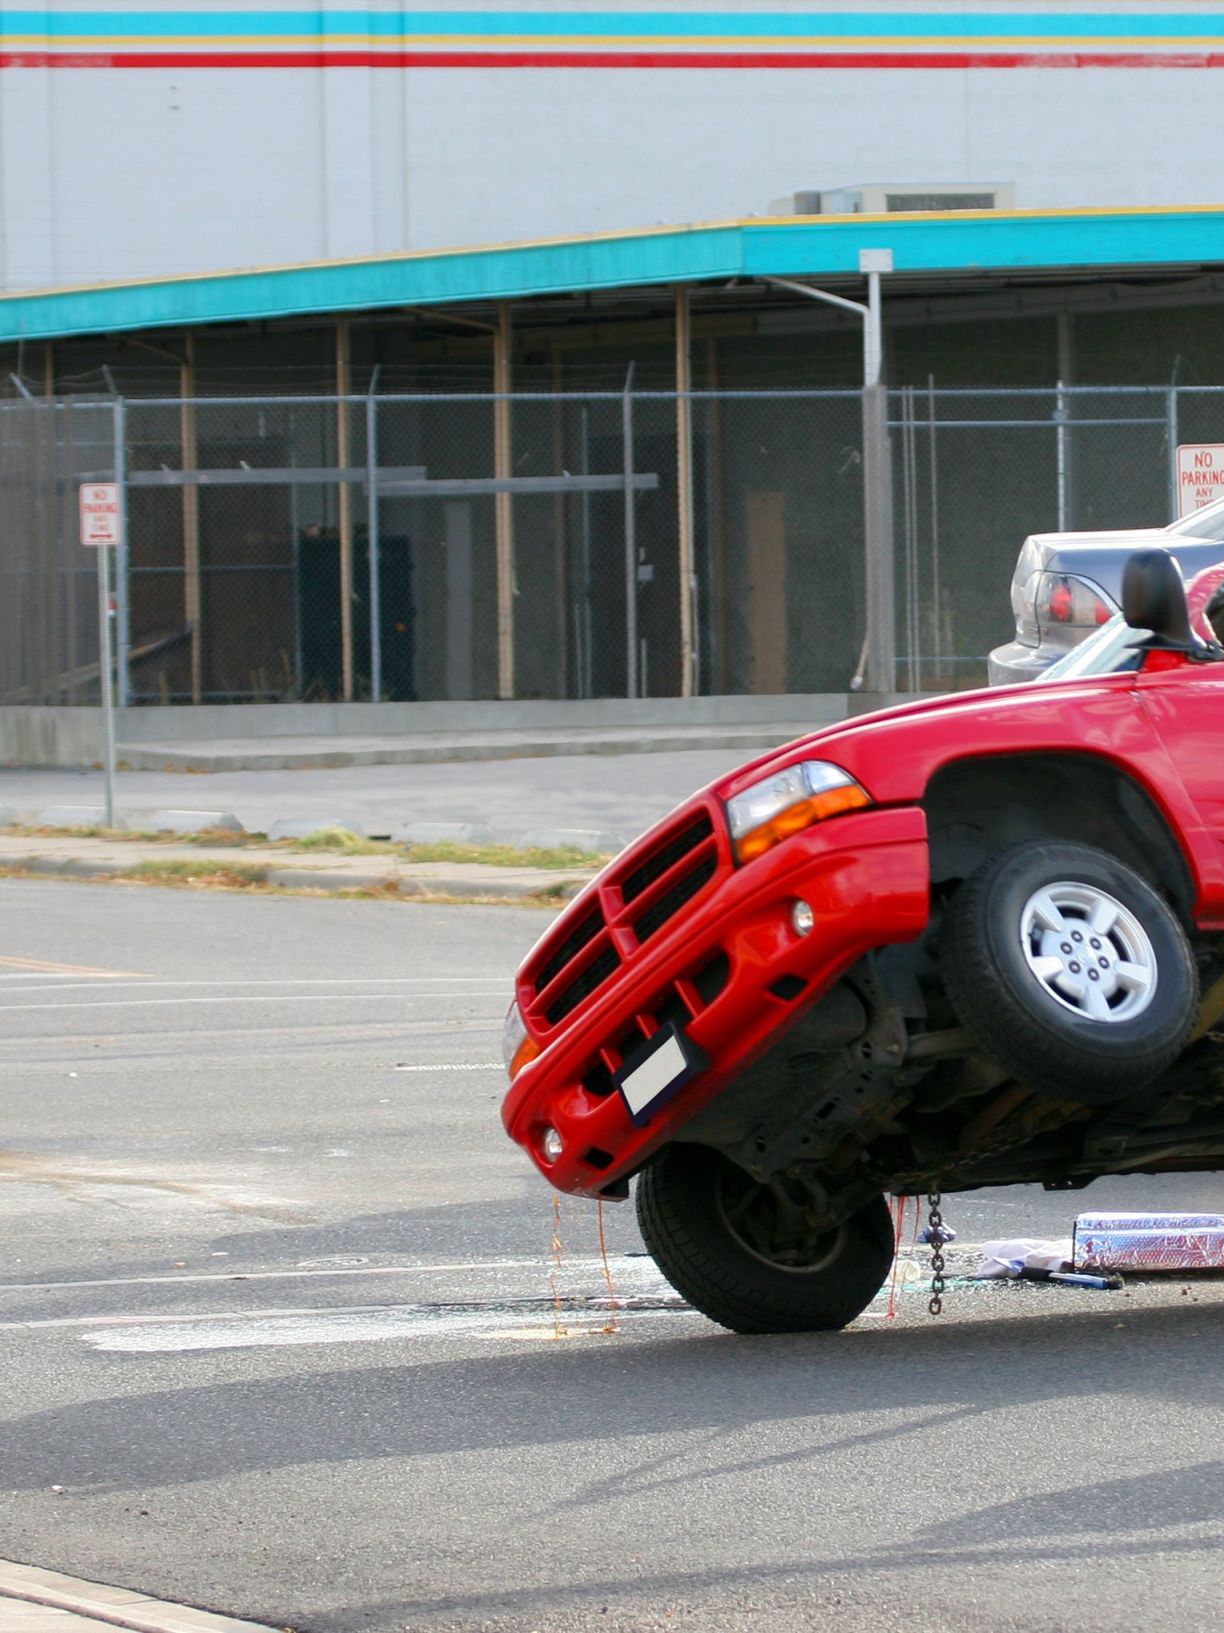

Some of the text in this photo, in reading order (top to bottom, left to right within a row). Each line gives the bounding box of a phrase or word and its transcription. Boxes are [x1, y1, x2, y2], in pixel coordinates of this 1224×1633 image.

[1194, 452, 1213, 468] NO
[1195, 487, 1213, 497] ANY
[1195, 499, 1216, 510] TIM
